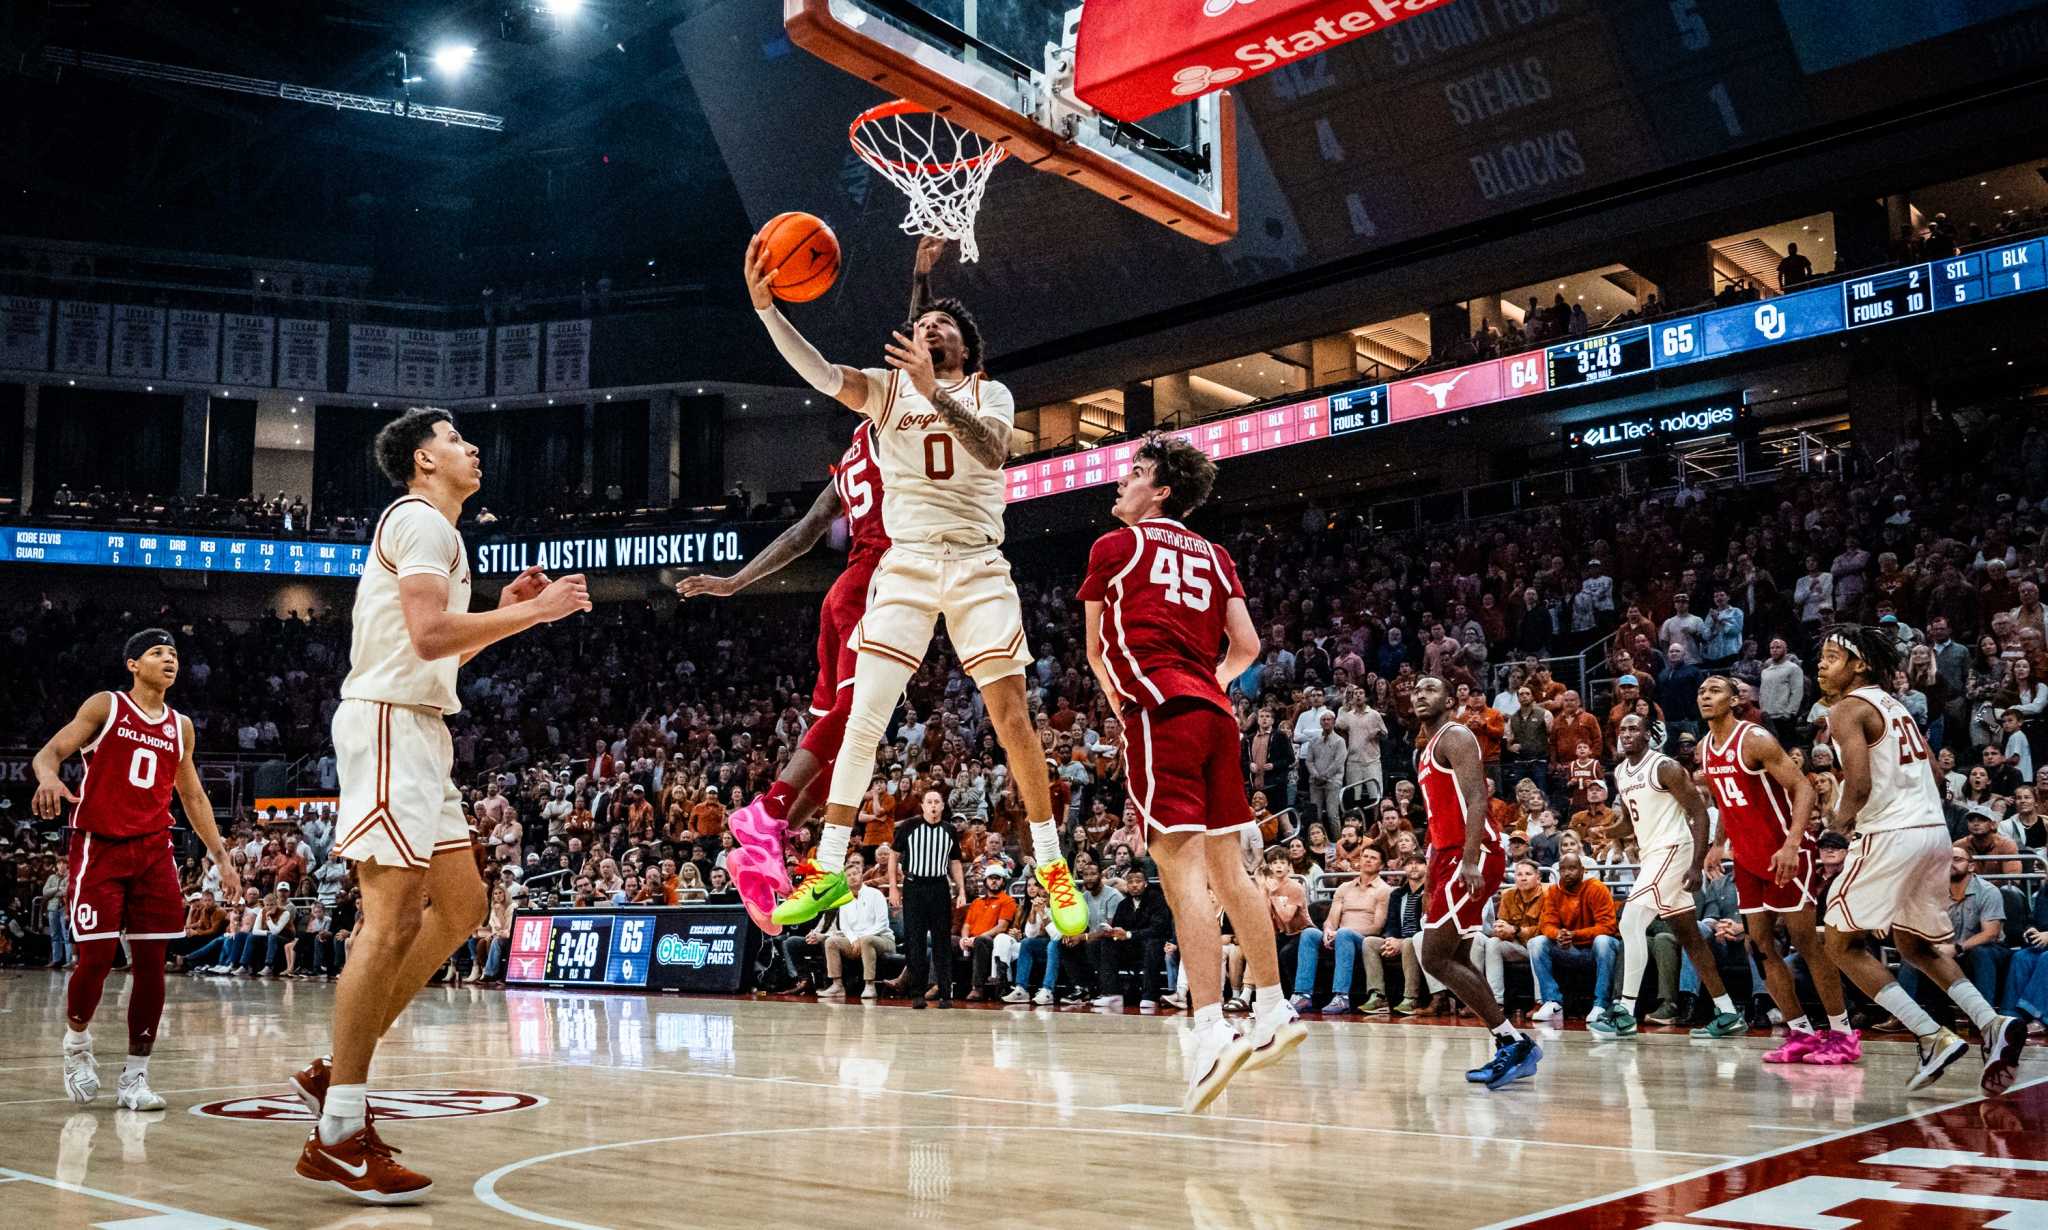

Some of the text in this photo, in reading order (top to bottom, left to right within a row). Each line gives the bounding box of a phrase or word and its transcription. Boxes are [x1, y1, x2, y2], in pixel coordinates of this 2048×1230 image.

[1445, 55, 1552, 126] STEALS
[1709, 80, 1744, 137] 1
[1314, 117, 1345, 161] 4
[1469, 128, 1586, 201] BLOCKS
[1346, 191, 1377, 237] 4
[2003, 247, 2028, 268] BLK
[1946, 261, 1969, 281] STL
[2012, 273, 2021, 291] 1
[1852, 270, 1920, 300] TOL 2
[1954, 284, 1966, 303] 5
[1853, 292, 1924, 323] FOULS 10
[1662, 323, 1694, 356] 65
[1577, 343, 1621, 374] 3:48
[1511, 358, 1539, 389] 64
[1370, 390, 1378, 406] 3
[1333, 409, 1379, 432] FOULS: 9
[1570, 406, 1734, 449] ELL Tecnologies
[923, 433, 955, 481] 0
[39, 532, 61, 545] ELVIS
[108, 536, 125, 549] PTS
[200, 541, 216, 553] REB
[230, 542, 246, 555] AST
[260, 543, 275, 556] FLS
[15, 546, 45, 560] GUARD
[112, 551, 120, 564] 5
[145, 553, 152, 565] 0
[175, 554, 182, 567] 3
[289, 545, 304, 557] STL
[319, 546, 336, 559] BLK
[351, 548, 362, 560] FT
[478, 531, 744, 573] STILL AUSTIN WHISKEY CO.
[205, 556, 212, 569] 3
[264, 558, 271, 571] 2
[294, 560, 301, 572] 2
[324, 561, 331, 574] 0
[1150, 546, 1213, 613] 45
[117, 727, 175, 753] OKLAHOMA
[1892, 716, 1928, 766] 20
[128, 747, 158, 789] 0
[1713, 777, 1748, 807] 14
[1629, 798, 1640, 822] 6
[521, 920, 543, 952] 64
[619, 920, 645, 953] 65
[689, 925, 737, 934] EXCLUSIVELY AT
[557, 932, 599, 967] 3:48
[657, 934, 710, 968] O'Reilly
[711, 939, 734, 952] AUTO
[706, 952, 735, 965] PARTS
